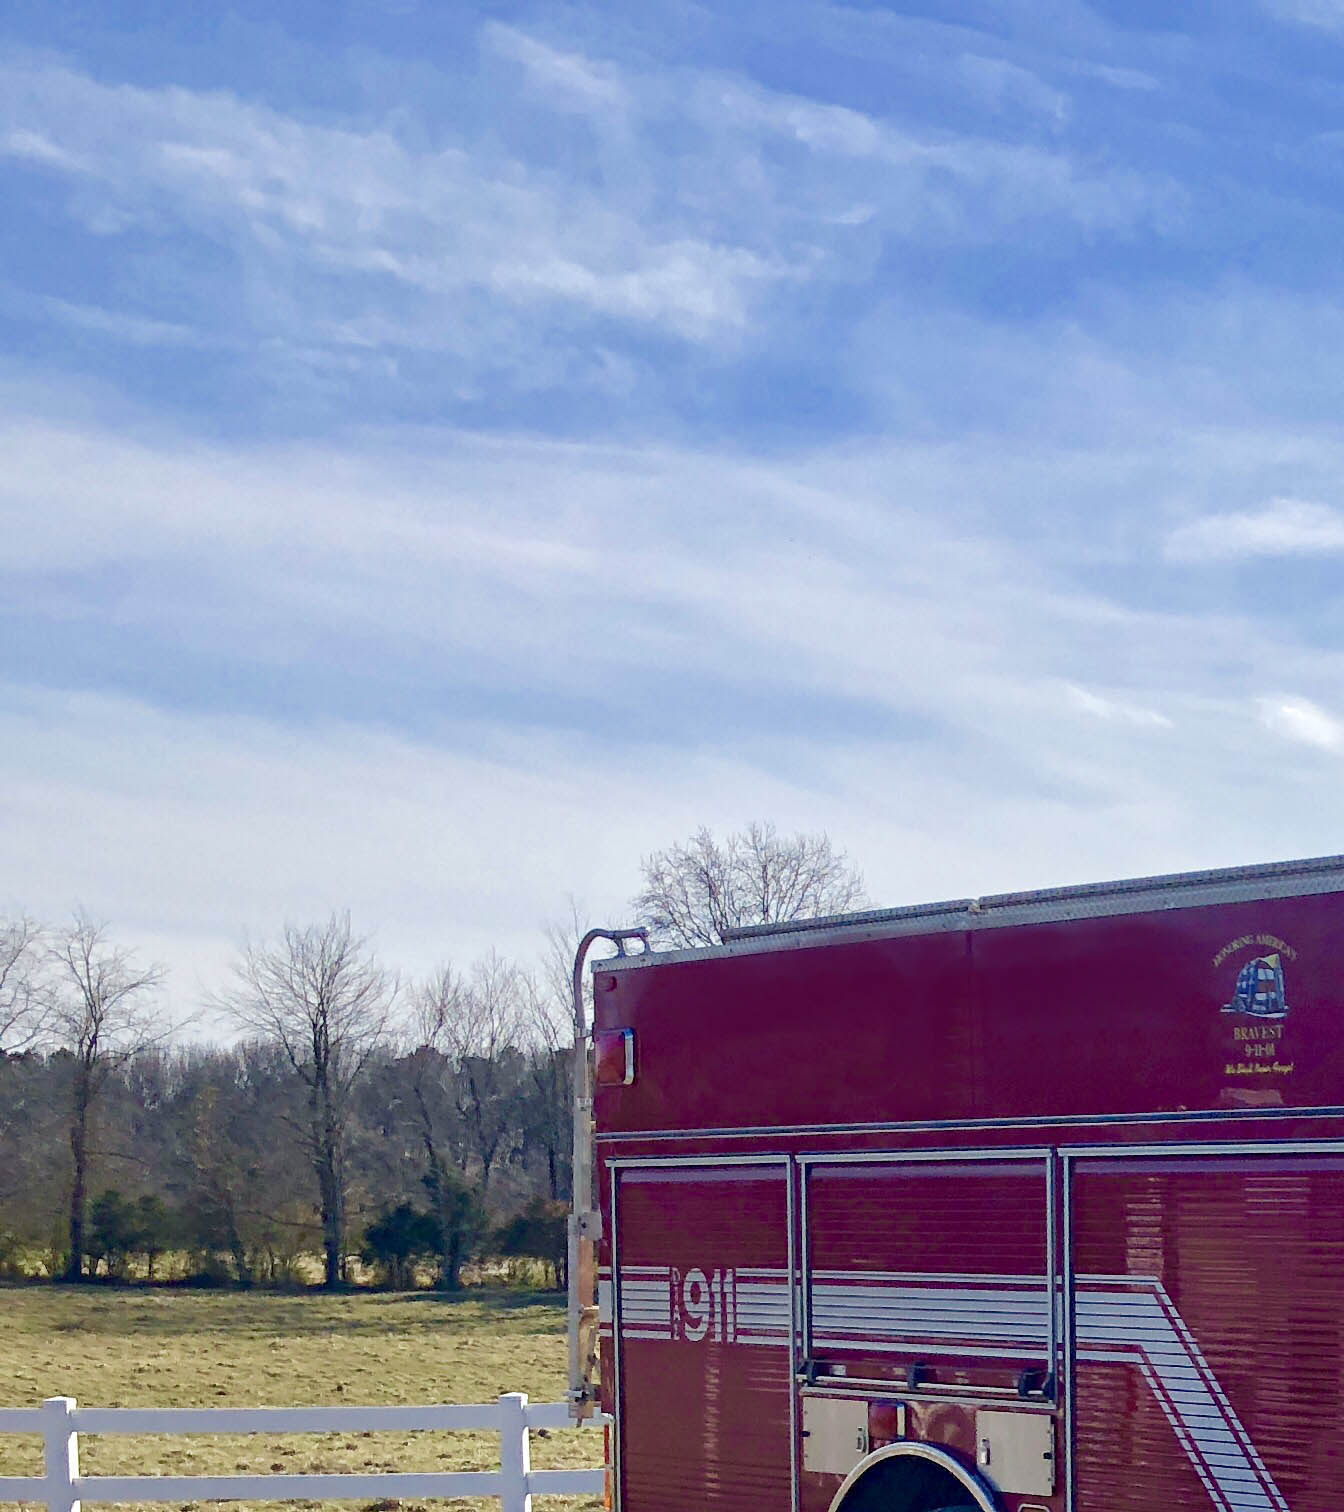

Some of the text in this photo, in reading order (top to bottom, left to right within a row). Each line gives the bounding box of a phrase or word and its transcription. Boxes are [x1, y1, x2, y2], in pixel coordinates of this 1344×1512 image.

[1233, 1024, 1285, 1041] BRAVEST
[671, 1267, 681, 1341] DIAL
[683, 1267, 735, 1343] 911
